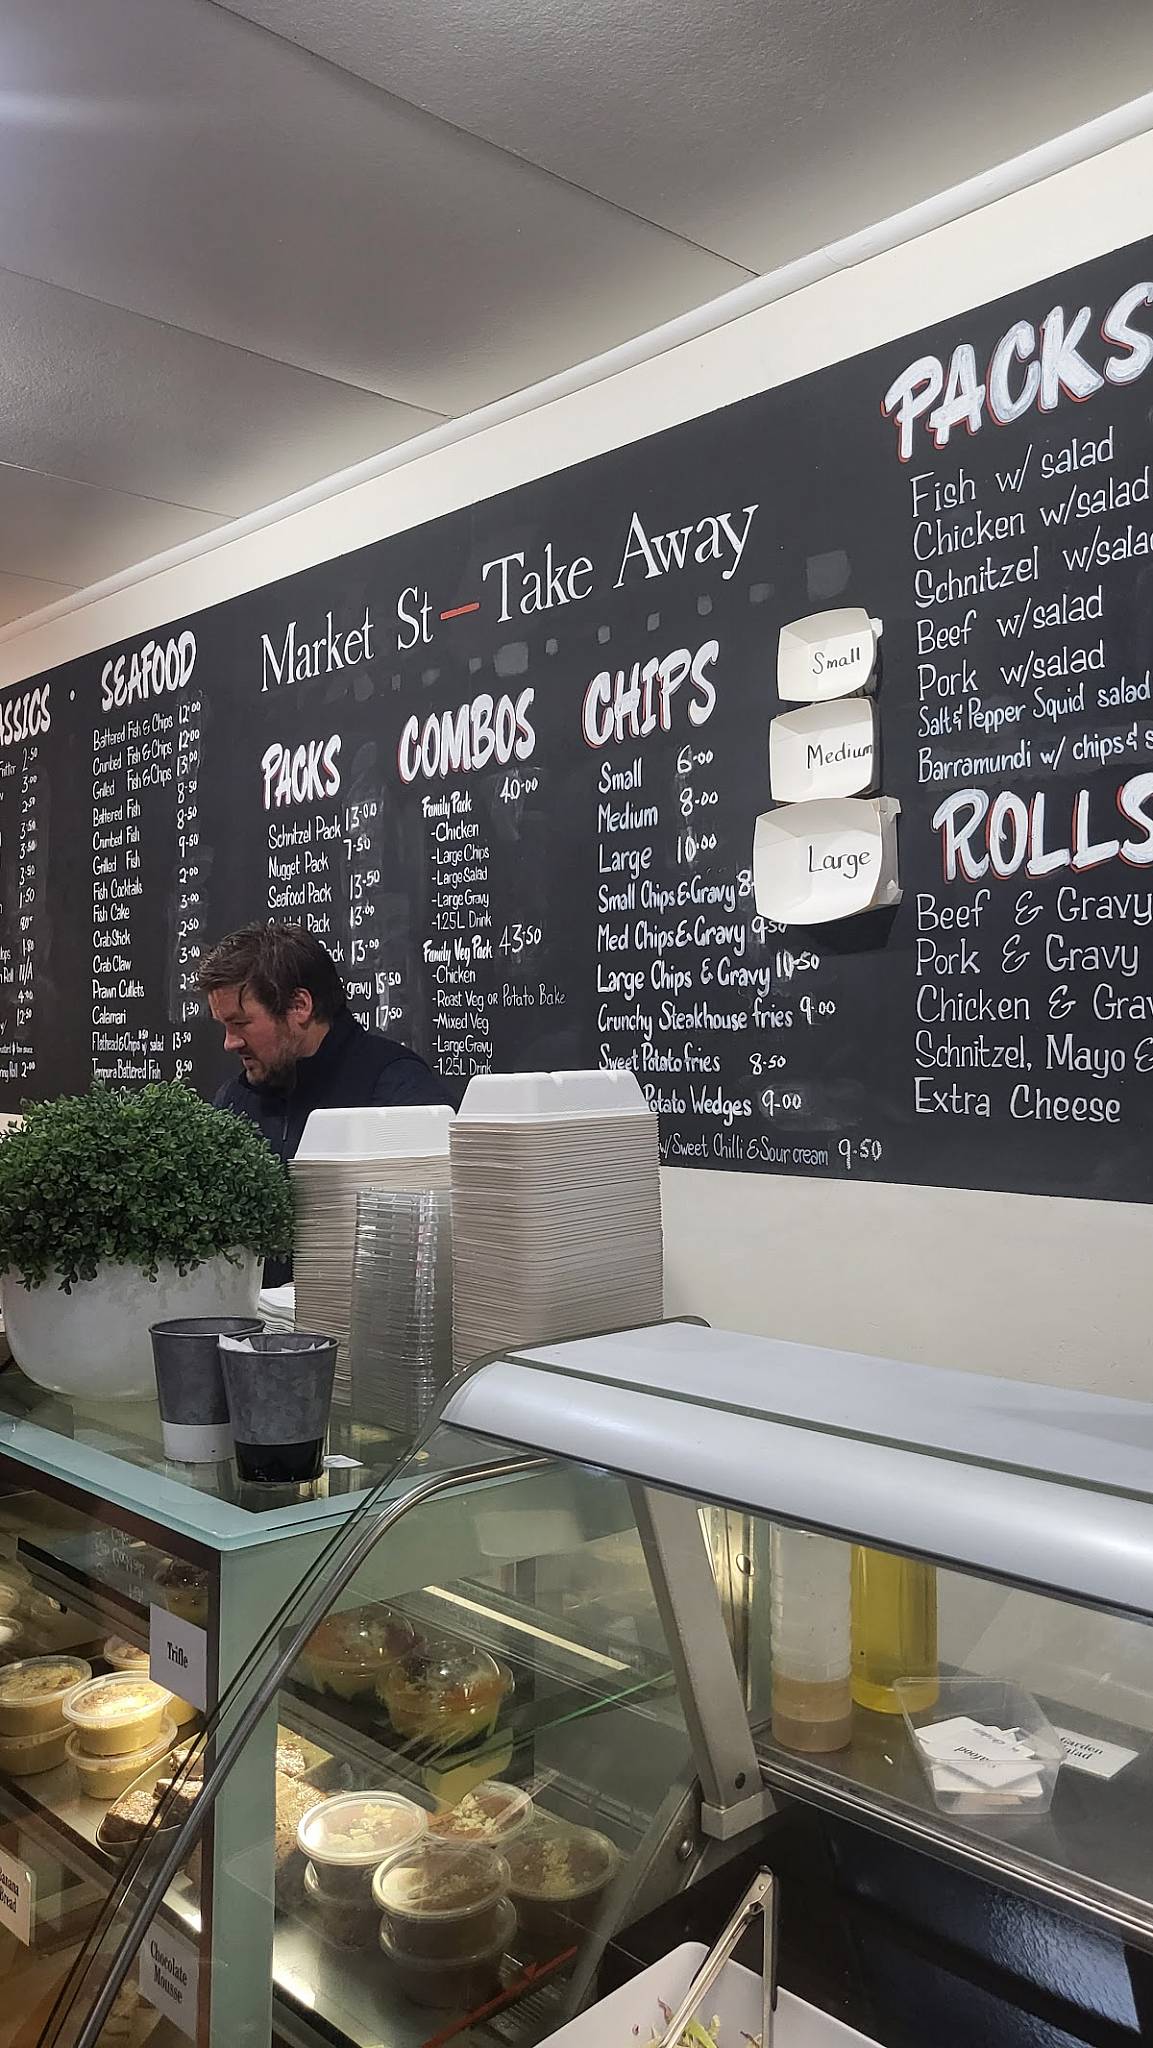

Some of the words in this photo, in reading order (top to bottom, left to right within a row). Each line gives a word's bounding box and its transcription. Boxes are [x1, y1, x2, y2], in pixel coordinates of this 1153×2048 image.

[881, 282, 1153, 462] PACKS
[909, 469, 976, 517] Fish
[1041, 425, 1114, 478] salad
[913, 510, 1026, 561] Chicken
[915, 545, 1039, 608] Schnitzel
[260, 607, 374, 692] Market
[397, 586, 434, 652] St
[482, 542, 594, 623] Take
[613, 504, 759, 590] Away
[917, 609, 977, 654] Beef
[102, 631, 196, 711] SEAFOOD
[812, 647, 861, 675] Small
[582, 639, 720, 748] CHIPS
[918, 660, 978, 700] Pork
[968, 697, 1026, 733] Pepper
[1033, 682, 1084, 723] Squid
[1097, 671, 1150, 708] salad
[94, 724, 125, 751] Battered
[128, 720, 141, 740] Fish
[152, 713, 173, 733] Chips
[397, 687, 536, 784] COMBOS
[127, 746, 140, 766] Fish
[151, 739, 172, 760] Chips
[807, 742, 873, 769] Medium
[918, 739, 1031, 783] Barramundi
[1072, 734, 1124, 765] chips
[93, 778, 114, 800] Grilled
[127, 769, 141, 792] Fish
[151, 763, 172, 787] Chips
[262, 734, 341, 810] PACKS
[598, 758, 642, 794] Small
[93, 805, 122, 827] Battered
[127, 799, 140, 819] Fish
[422, 795, 450, 819] Family
[451, 791, 472, 814] Pack
[598, 801, 658, 833] Medium
[126, 825, 140, 844] Fish
[269, 820, 311, 849] Schnitzel
[316, 815, 341, 841] Pack
[933, 772, 1153, 883] ROLLS
[93, 855, 117, 875] Grilled
[126, 849, 140, 870] Fish
[269, 854, 300, 880] Nugget
[305, 851, 329, 874] Pack
[464, 844, 490, 862] Chips
[599, 843, 652, 879] Large
[809, 845, 871, 879] Large
[93, 881, 108, 901] Fish
[111, 875, 142, 899] Cocktails
[463, 867, 488, 883] Salad
[268, 884, 305, 908] Seafood
[308, 882, 332, 904] Pack
[465, 889, 489, 908] Gravy
[598, 882, 635, 913] Small
[916, 889, 991, 931] Beef
[1014, 890, 1043, 926] &
[1057, 886, 1153, 926] Gravy
[93, 904, 107, 923] Fish
[111, 903, 130, 921] Cake
[307, 913, 330, 933] Pack
[469, 910, 492, 928] Drink
[423, 939, 451, 966] Family
[454, 937, 470, 967] Veg
[472, 935, 493, 959] Pack
[598, 923, 628, 952] Med
[93, 954, 111, 973] Crab
[113, 954, 131, 971] Claw
[916, 938, 981, 976] Pork
[1001, 934, 1031, 973] &
[1046, 934, 1139, 977] Gravy
[92, 979, 116, 999] Prawn
[119, 979, 144, 998] Cutlets
[346, 981, 371, 1000] gravy
[598, 963, 645, 1001] Large
[650, 960, 692, 996] Chips
[701, 958, 713, 985] &
[717, 957, 770, 997] Gravy
[465, 991, 484, 1012] Veg
[502, 983, 534, 1007] Potato
[539, 983, 566, 1006] Bake
[917, 984, 1031, 1023] Chicken
[1049, 984, 1076, 1019] &
[92, 1005, 126, 1025] Calamari
[470, 1013, 489, 1035] Veg
[598, 1001, 653, 1040] Crunchy
[660, 1000, 748, 1032] Steakhouse
[752, 998, 794, 1030] fries
[465, 1035, 492, 1058] Gravy
[599, 1043, 639, 1072] Sweet
[641, 1042, 682, 1072] Potato
[683, 1042, 720, 1073] fries
[1046, 1033, 1125, 1078] Mayo
[149, 1059, 161, 1080] Fish
[470, 1058, 492, 1075] Drink
[690, 1084, 752, 1126] Wedges
[914, 1077, 991, 1117] Extra
[1010, 1084, 1121, 1123] Cheese
[714, 1134, 742, 1160] Chilli
[167, 1641, 188, 1668] Trifle
[151, 1940, 187, 1986] Chocolate
[154, 1964, 182, 2004] Mousse
